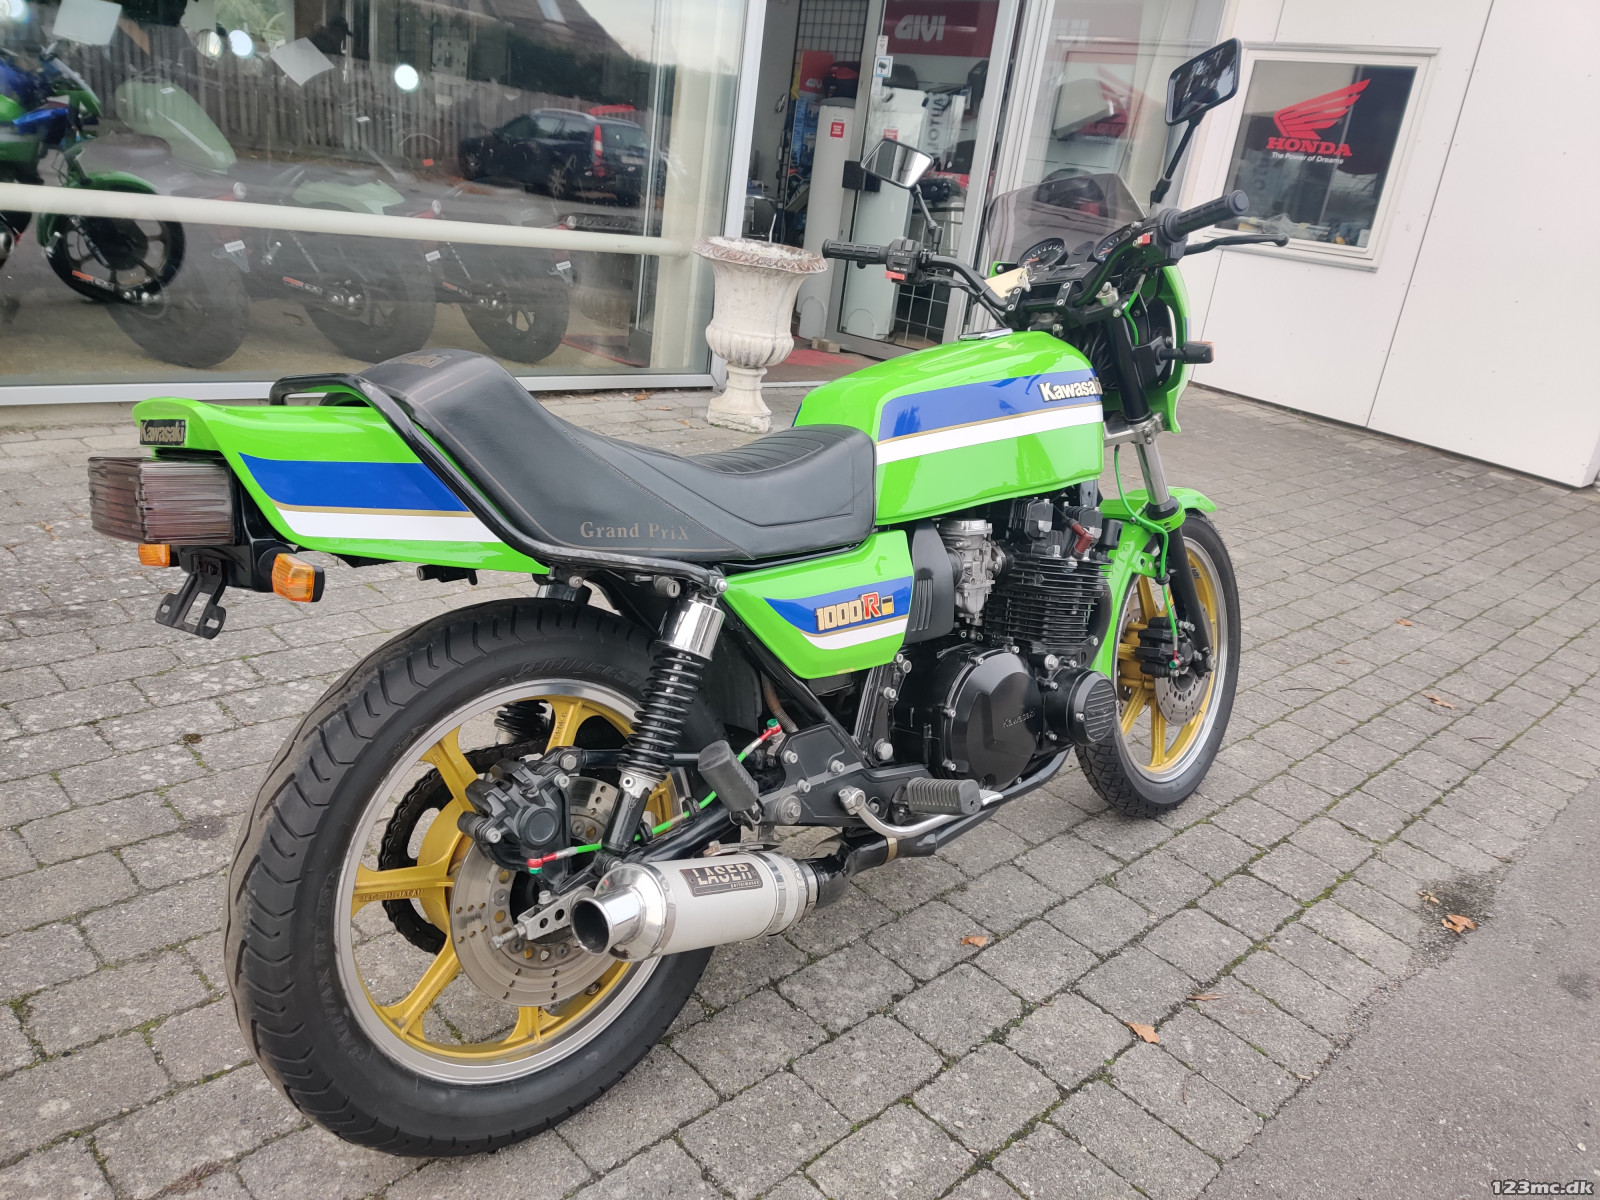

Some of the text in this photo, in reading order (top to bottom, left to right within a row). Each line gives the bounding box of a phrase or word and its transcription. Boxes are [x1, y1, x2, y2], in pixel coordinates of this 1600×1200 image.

[894, 14, 946, 42] GIVI
[1266, 137, 1352, 156] HONDA
[1272, 151, 1285, 159] The
[1285, 152, 1306, 161] Power
[1316, 156, 1344, 164] Dreams
[140, 421, 185, 443] Kawasaki
[580, 521, 640, 538] Grand
[815, 591, 881, 631] 1000R
[692, 864, 752, 885] LASER
